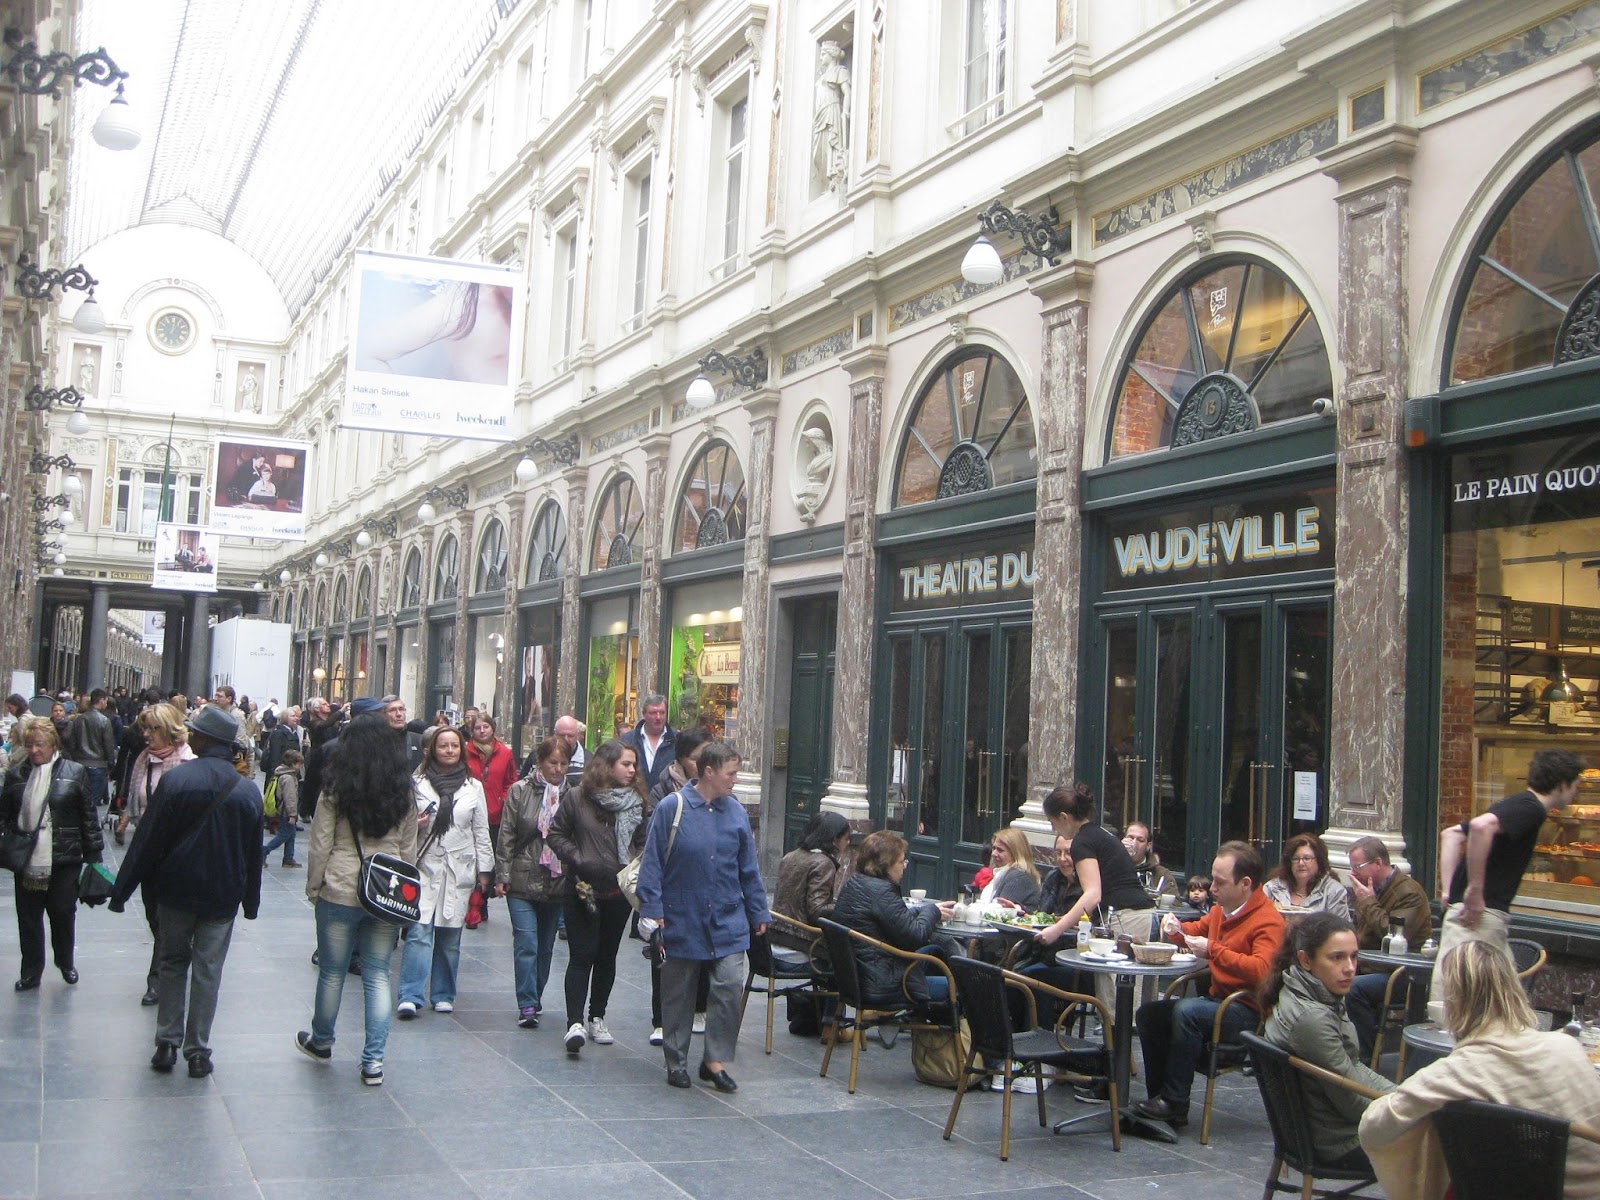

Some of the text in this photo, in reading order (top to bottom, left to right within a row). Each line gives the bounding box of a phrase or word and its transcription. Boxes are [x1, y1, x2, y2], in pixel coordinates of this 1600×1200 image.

[352, 385, 410, 398] Hakan Simsek
[1453, 481, 1481, 502] LE
[1486, 473, 1539, 498] PAIN
[1113, 506, 1320, 577] VAUDEVILLE
[900, 550, 1036, 599] THEATRE DU
[375, 894, 418, 917] SURINAME
